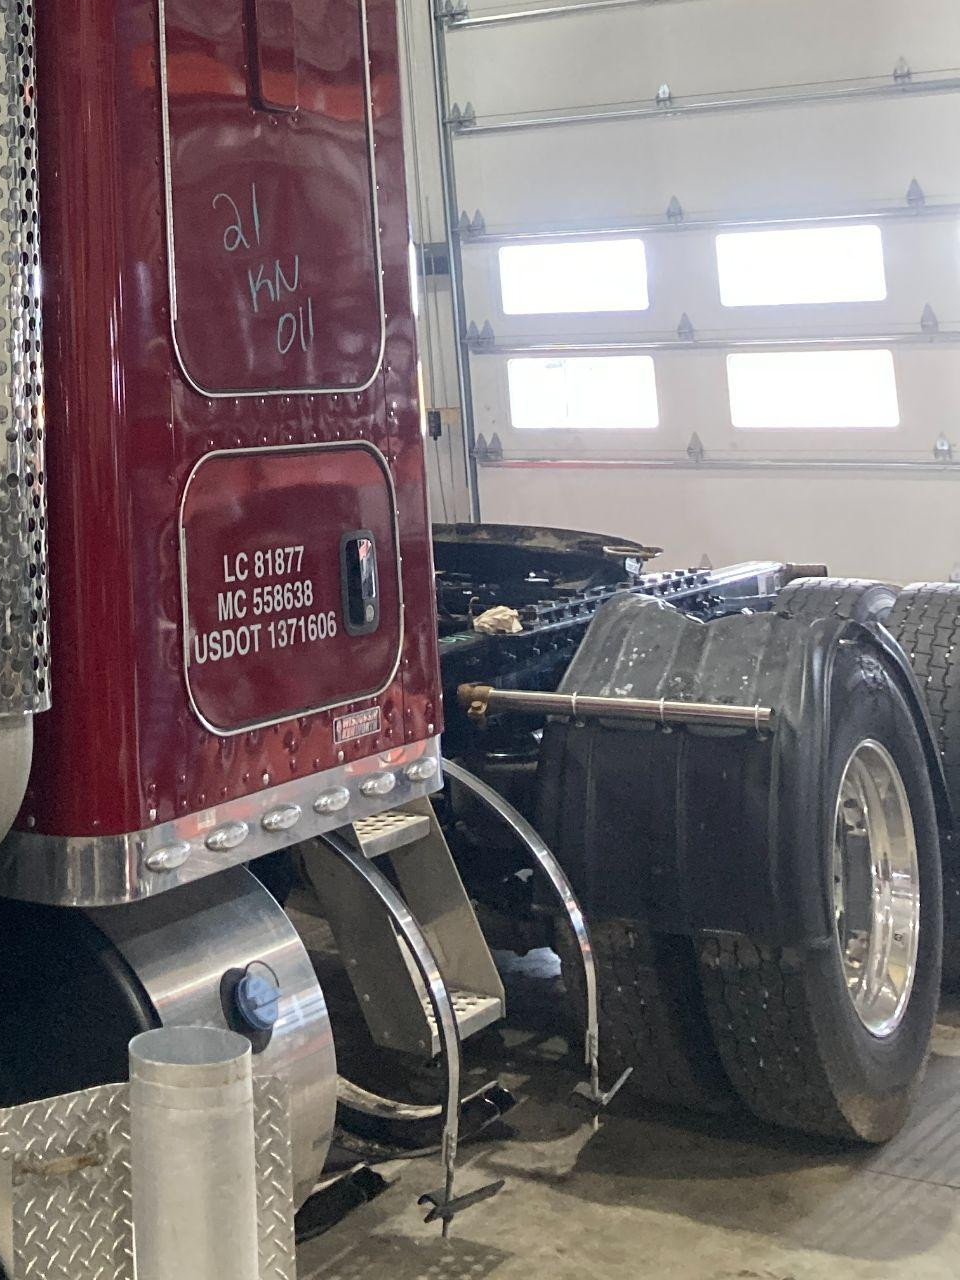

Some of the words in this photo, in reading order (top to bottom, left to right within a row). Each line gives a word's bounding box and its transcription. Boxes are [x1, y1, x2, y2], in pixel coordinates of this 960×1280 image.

[212, 182, 260, 252] 21
[223, 551, 249, 583] LC
[253, 545, 305, 579] 81877
[217, 589, 248, 621] MC
[252, 579, 314, 616] 558638
[194, 623, 263, 664] USDOT
[267, 610, 337, 650] 1371606
